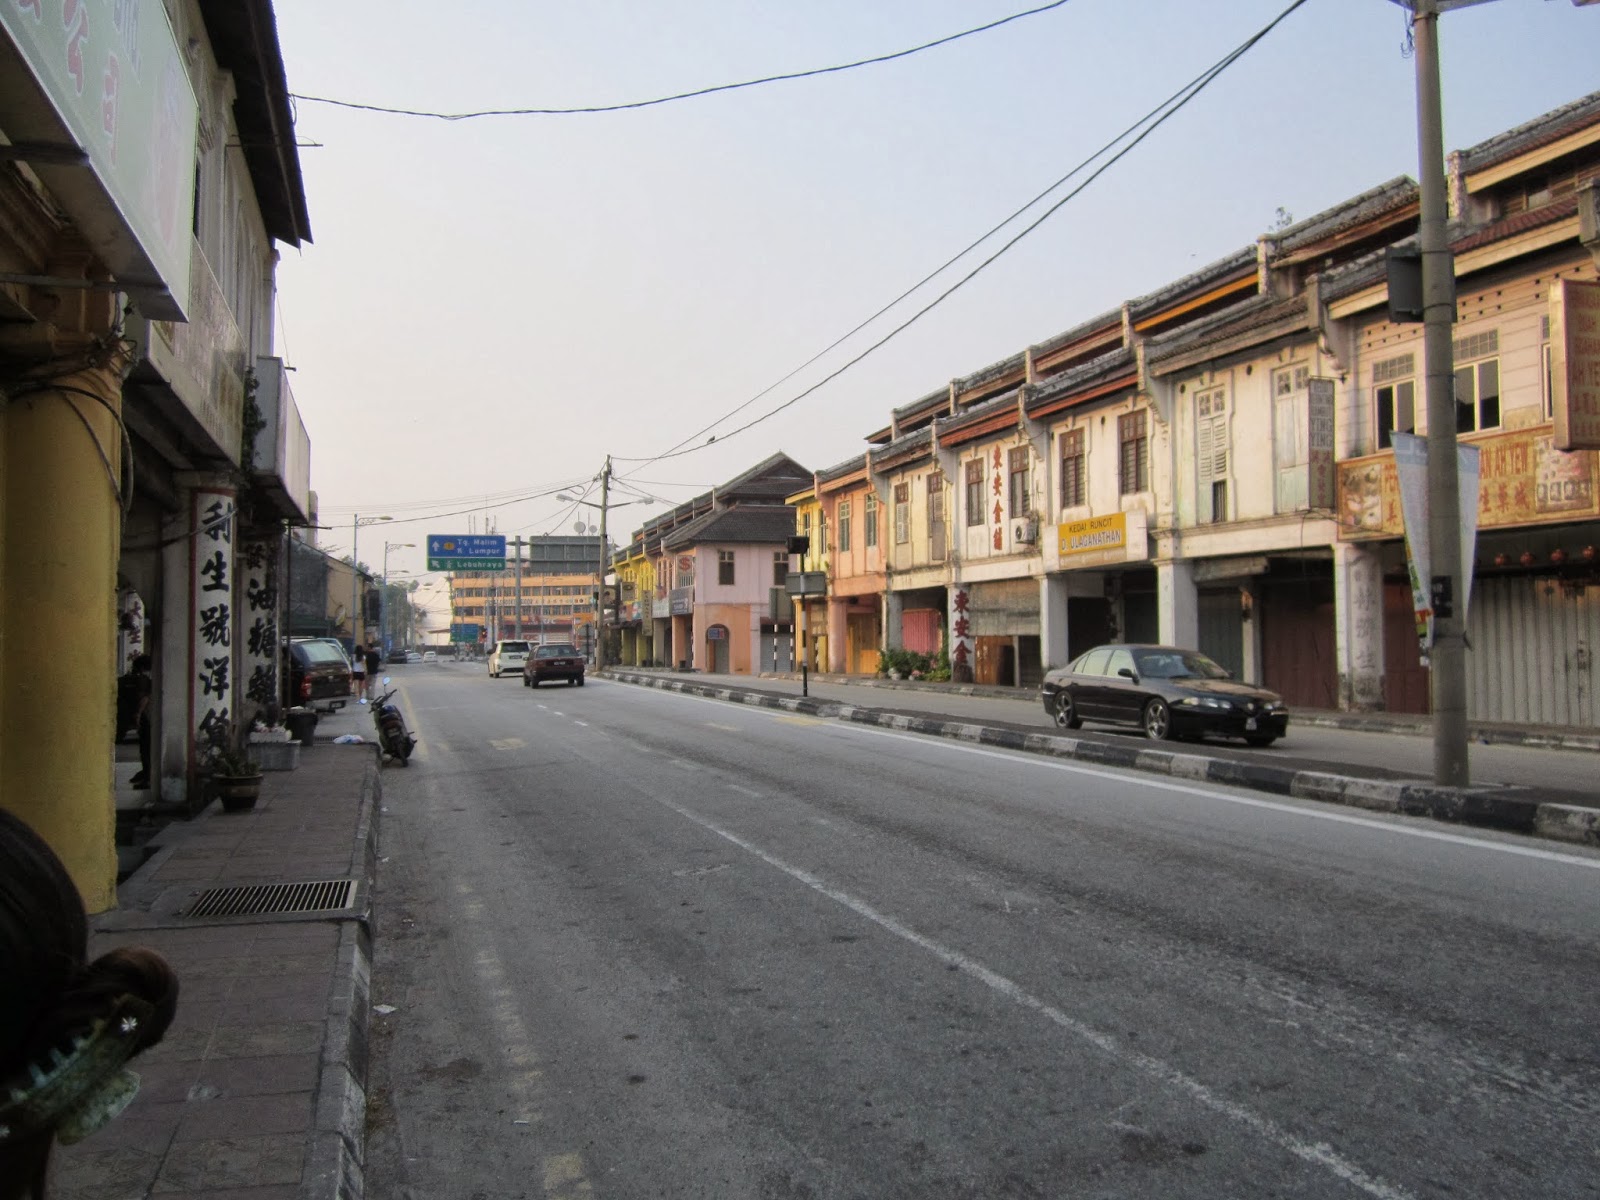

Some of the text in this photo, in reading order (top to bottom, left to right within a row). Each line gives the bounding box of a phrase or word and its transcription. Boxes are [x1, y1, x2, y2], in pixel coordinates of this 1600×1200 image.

[1068, 517, 1113, 534] KEDAI RUNCIT
[474, 538, 497, 546] Malim
[469, 548, 501, 556] Lumpur
[456, 560, 503, 569] Lebuhraya
